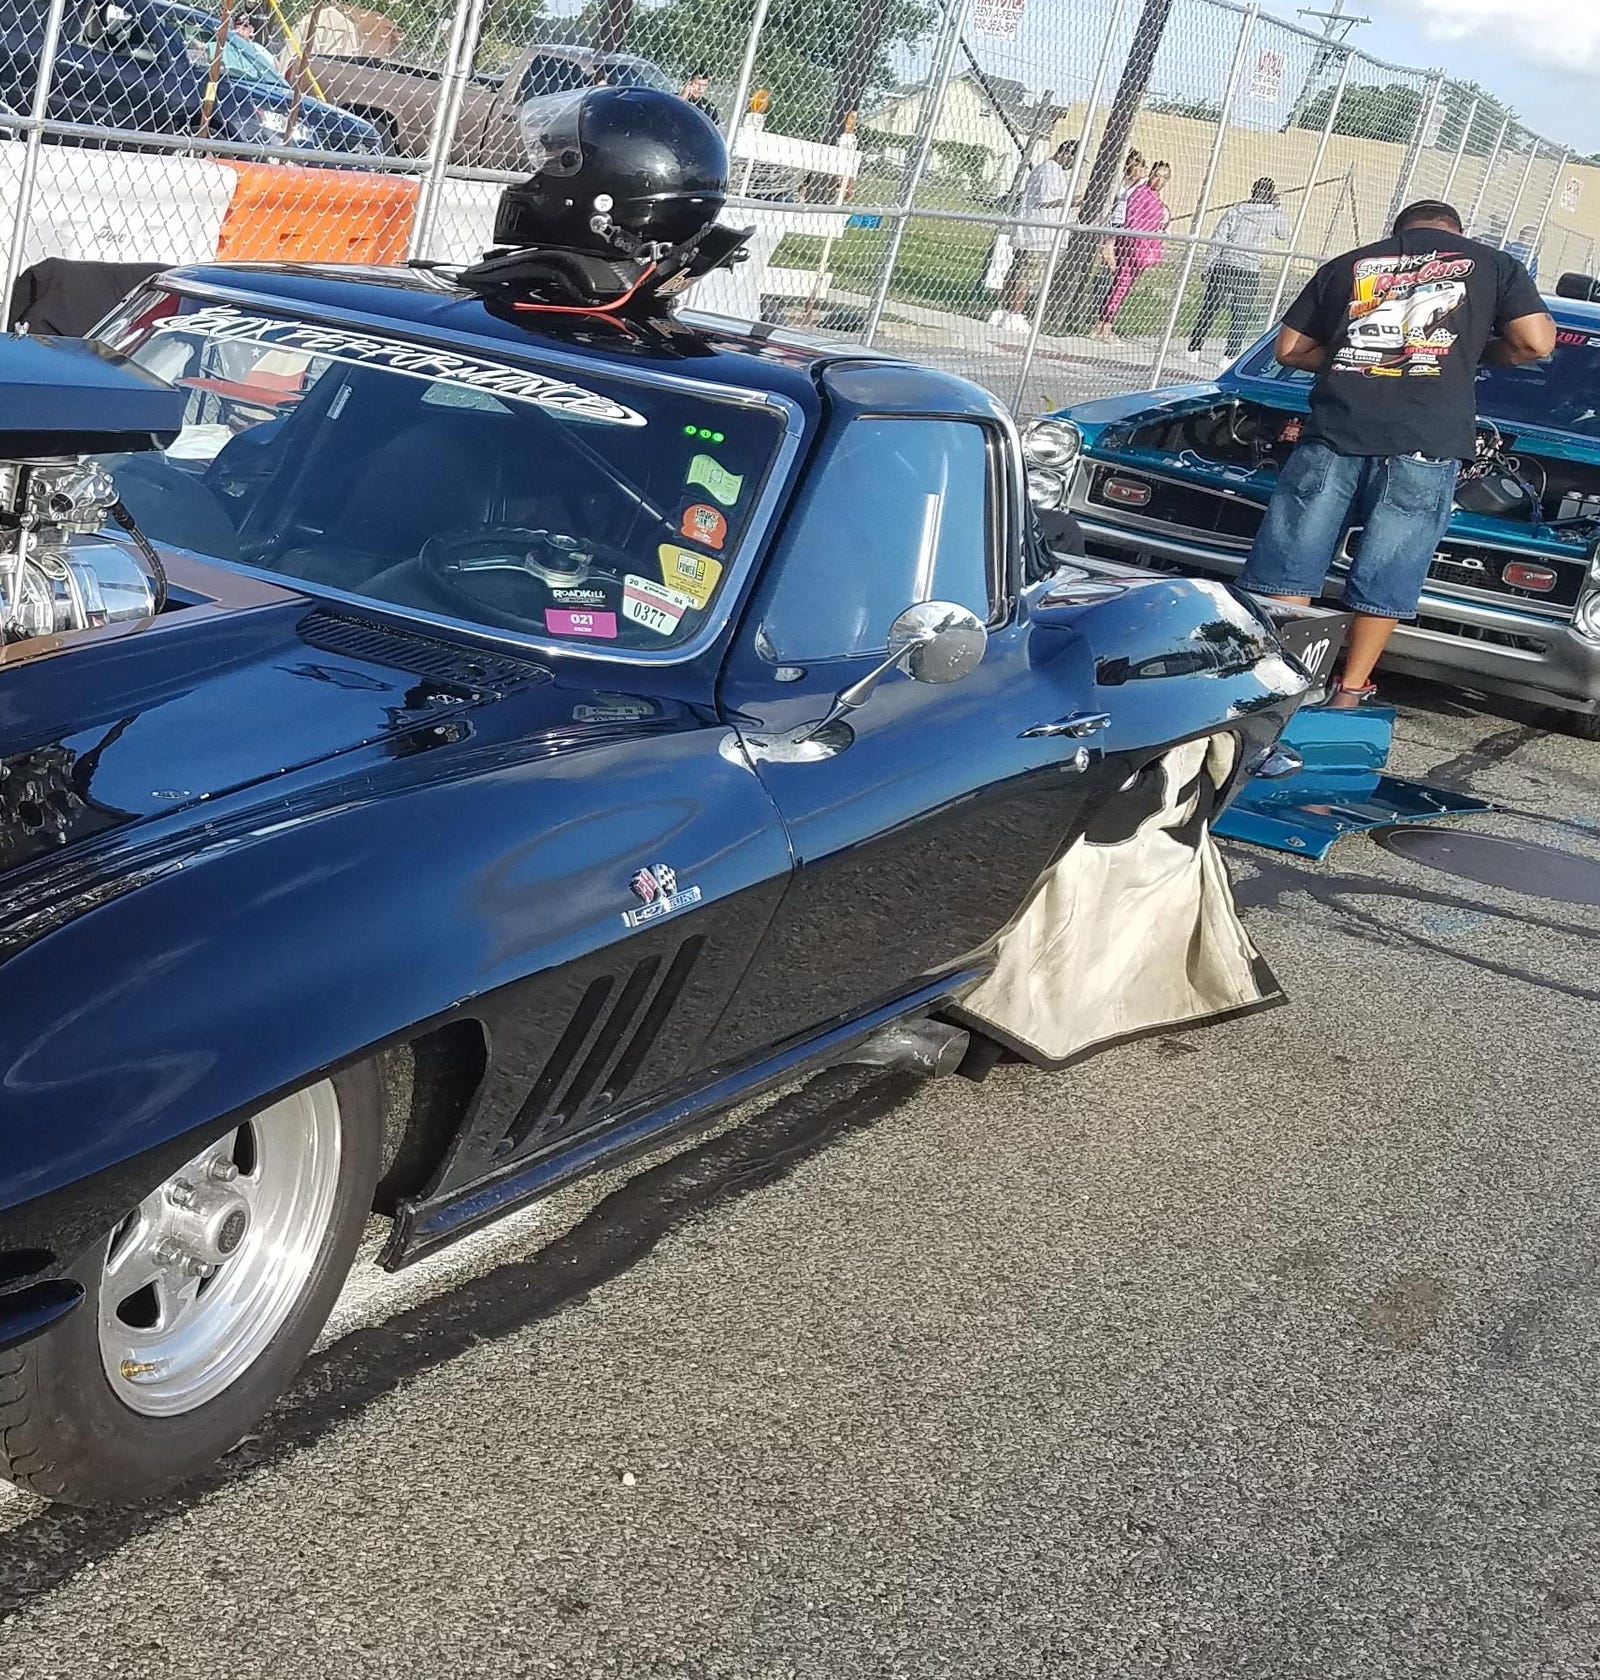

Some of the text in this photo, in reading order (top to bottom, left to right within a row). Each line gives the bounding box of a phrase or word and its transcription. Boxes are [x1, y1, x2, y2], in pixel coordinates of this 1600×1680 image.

[275, 328, 625, 420] PERFORMANCE
[552, 588, 606, 599] ROADKILL
[570, 613, 594, 625] 021
[633, 602, 667, 628] 0377
